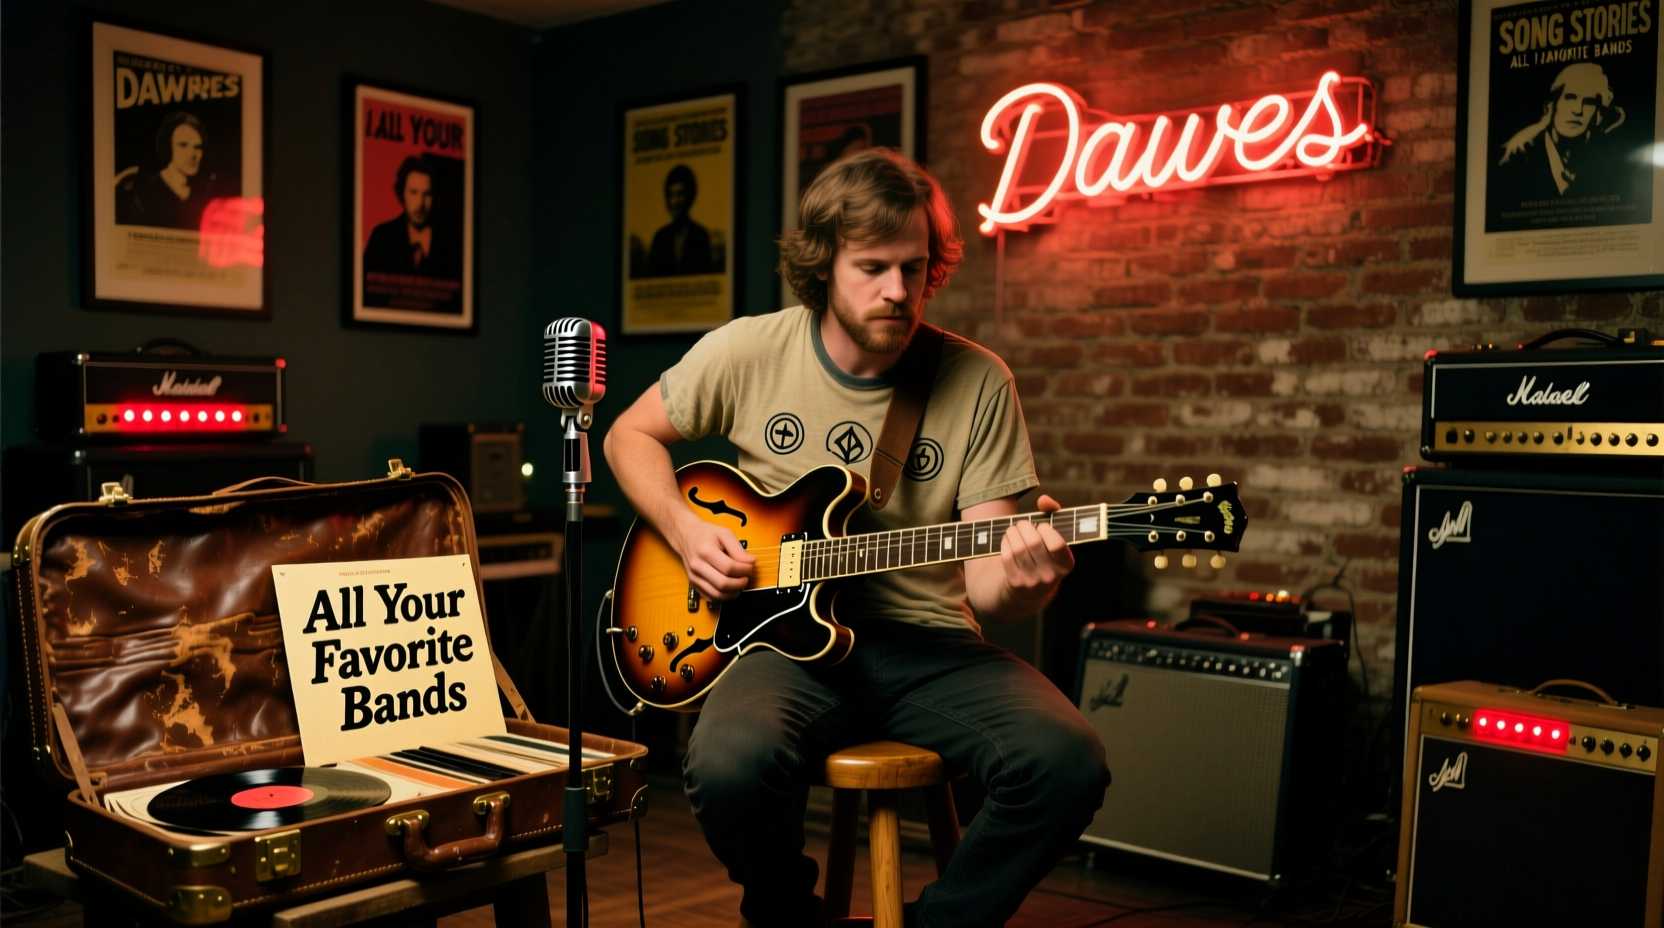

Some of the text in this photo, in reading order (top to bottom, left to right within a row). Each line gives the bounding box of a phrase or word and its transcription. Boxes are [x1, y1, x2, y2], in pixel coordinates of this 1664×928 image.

[1499, 13, 1564, 55] SONG
[1569, 1, 1651, 43] STORIES
[1594, 40, 1632, 58] BANDS
[410, 115, 464, 151] YOUR
[978, 71, 1368, 235] Dawes
[302, 582, 465, 634] All Your
[311, 626, 474, 685] Favorite
[340, 671, 468, 732] Bands
